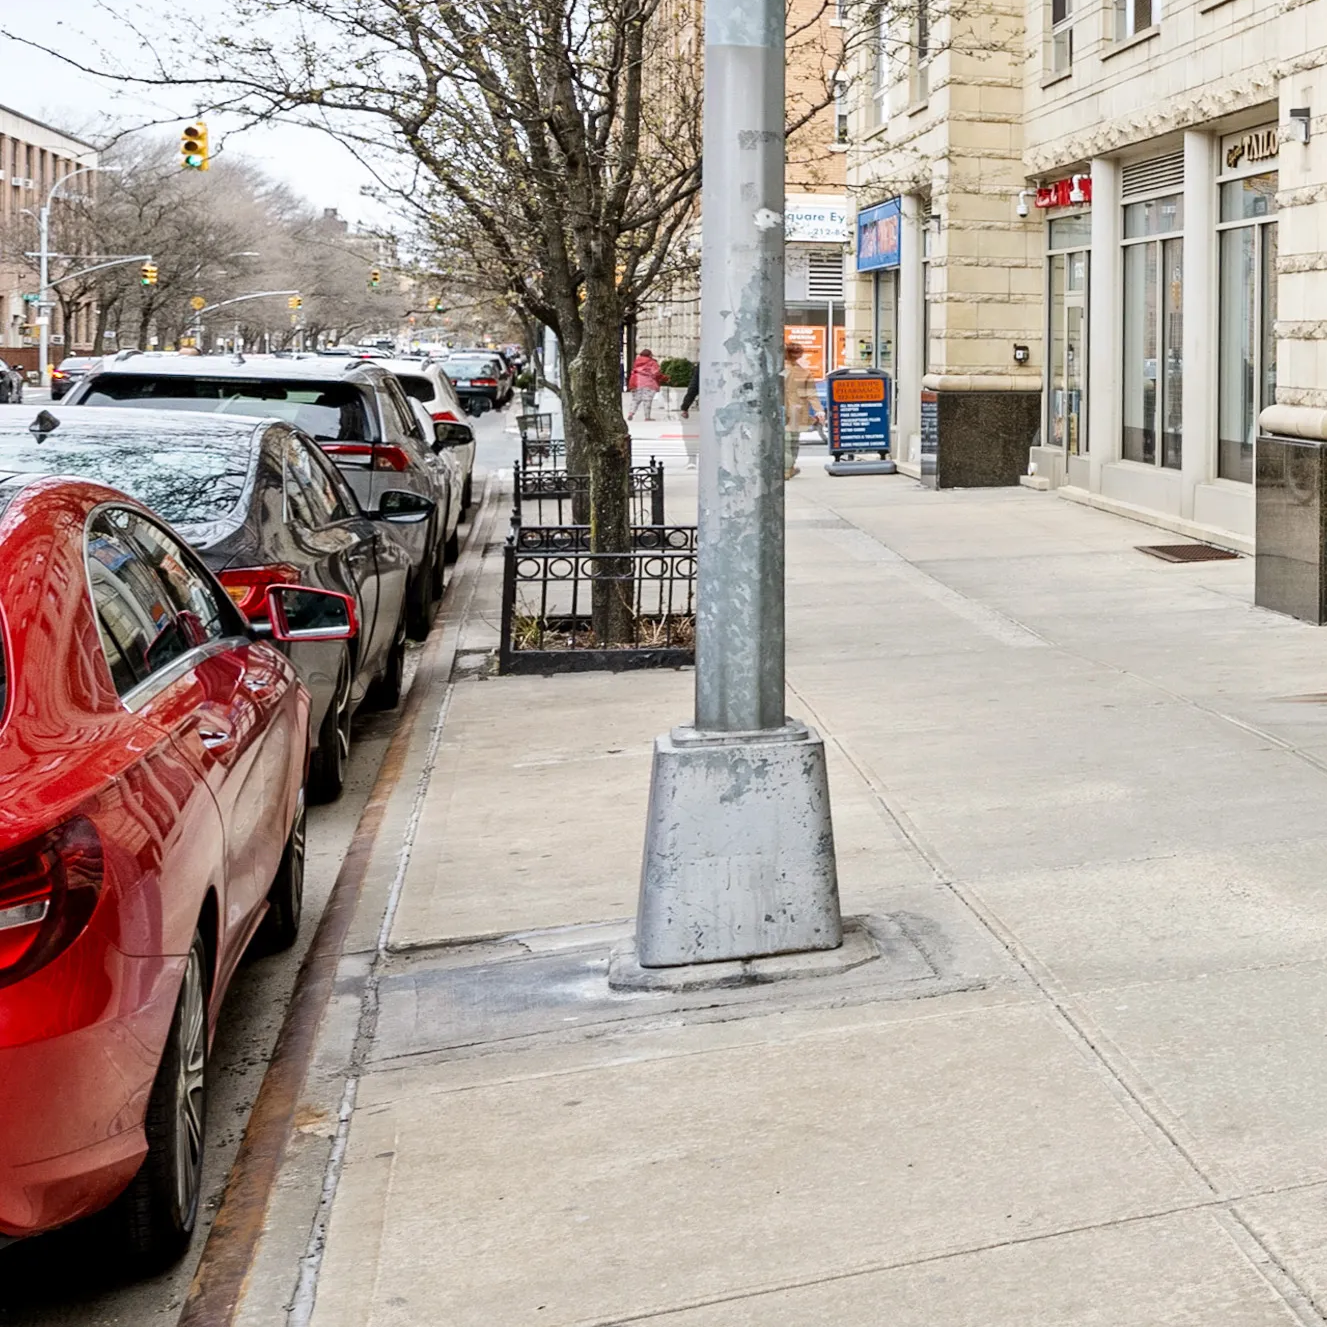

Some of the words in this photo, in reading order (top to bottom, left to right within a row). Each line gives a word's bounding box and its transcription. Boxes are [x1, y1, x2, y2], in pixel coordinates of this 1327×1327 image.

[1242, 127, 1278, 160] TAILO
[785, 213, 825, 222] quare
[830, 212, 845, 223] Ey
